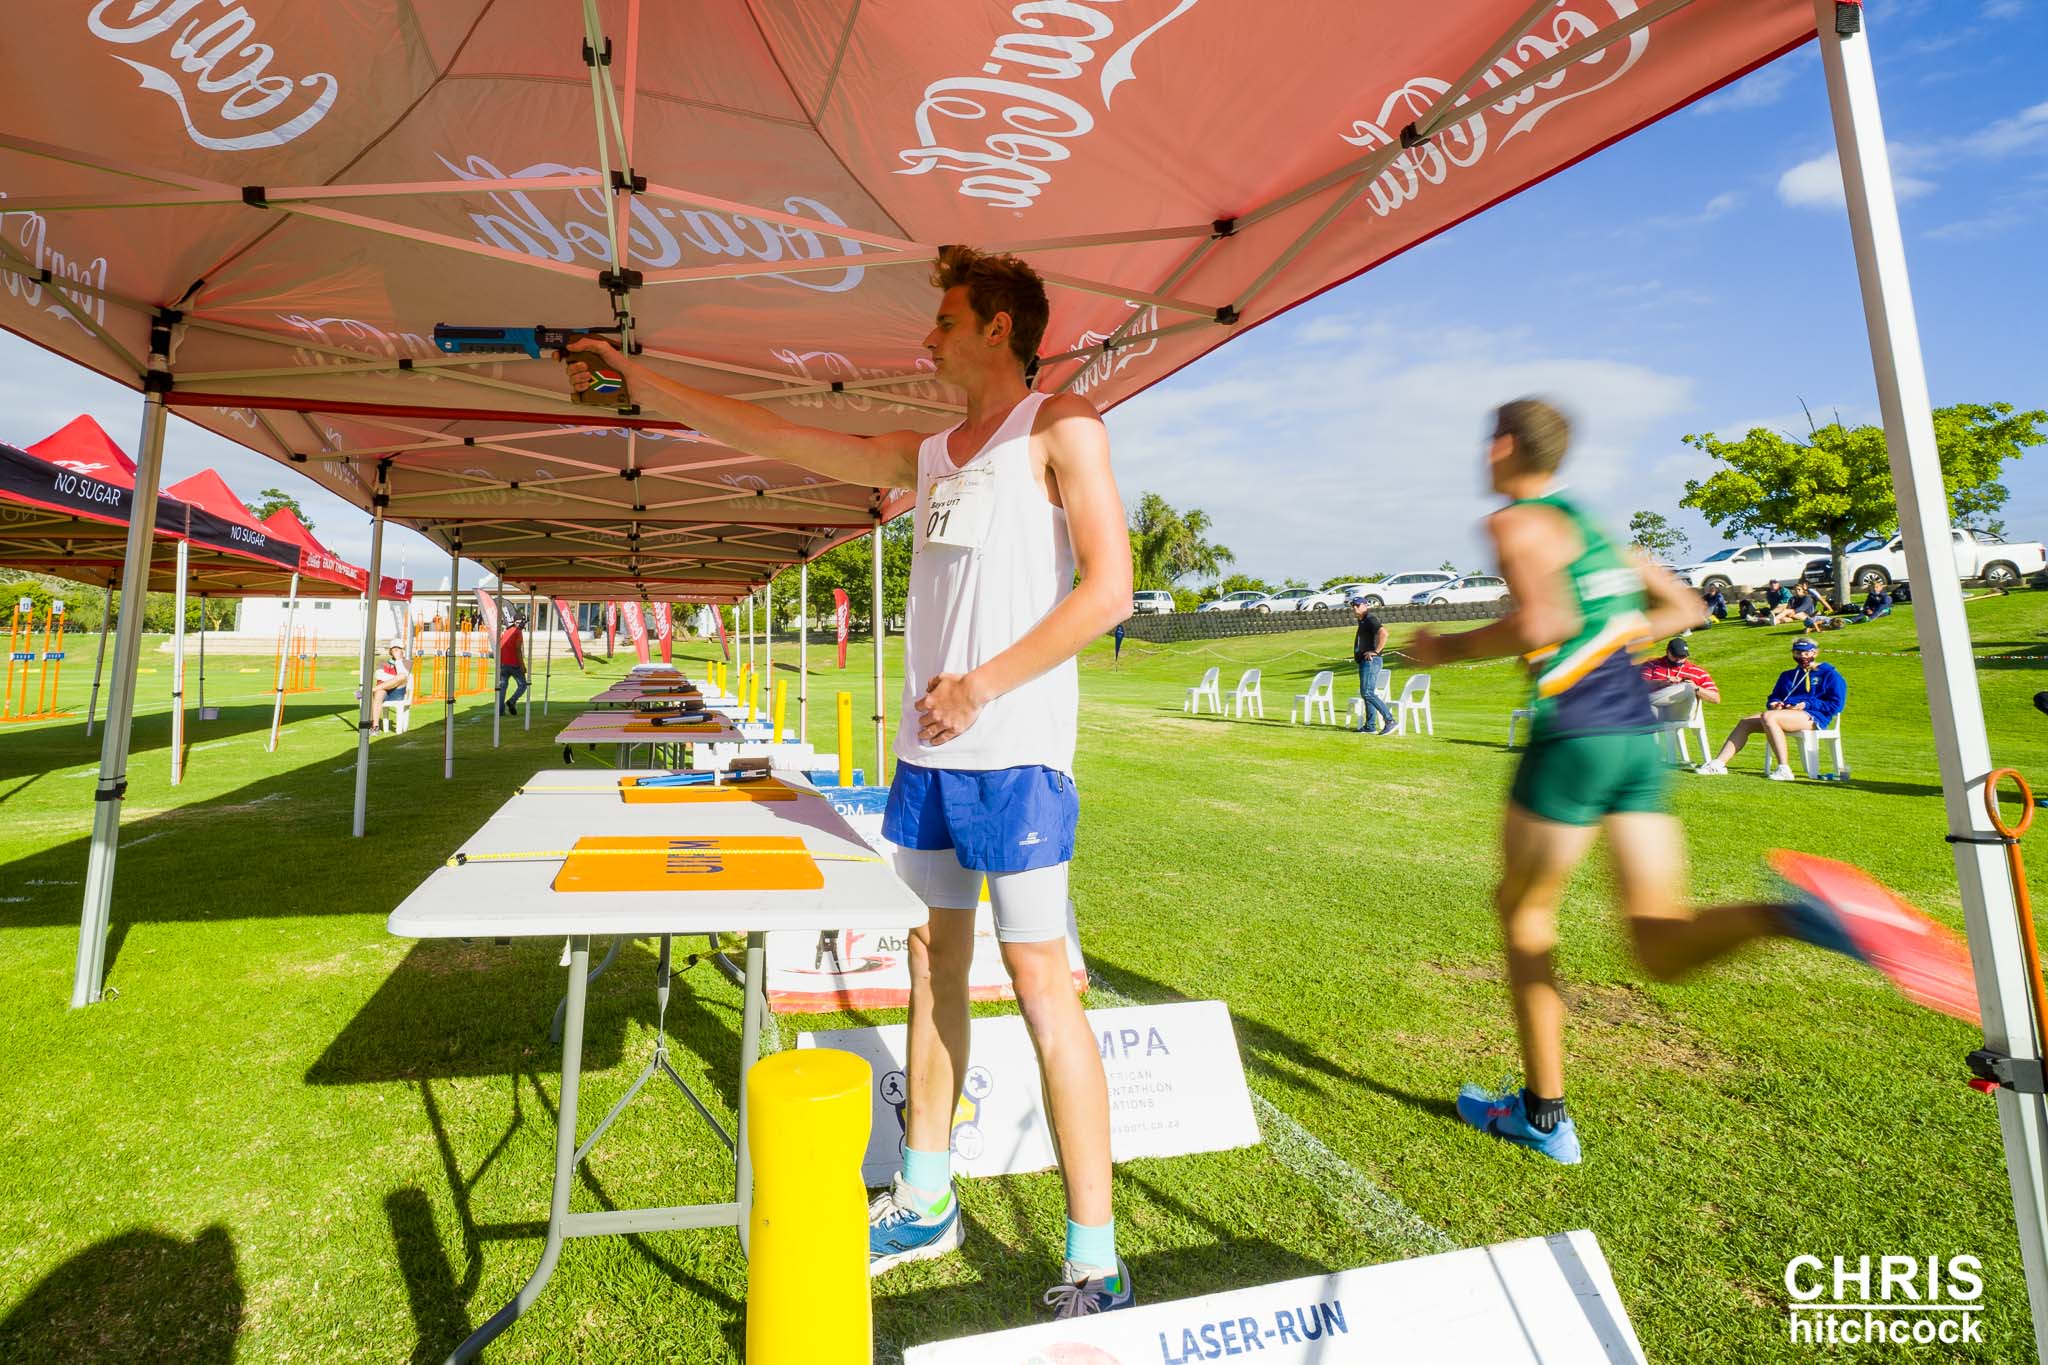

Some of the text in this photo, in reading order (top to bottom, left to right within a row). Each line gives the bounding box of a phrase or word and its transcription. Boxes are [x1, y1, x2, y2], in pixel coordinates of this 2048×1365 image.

[54, 472, 121, 507] NO SUGAR
[926, 509, 951, 538] 01
[231, 525, 266, 548] NO SUGAR
[833, 803, 865, 816] PM
[876, 935, 910, 953] Abs
[1098, 1026, 1170, 1060] MPA
[1108, 1082, 1173, 1096] ENTATHLON
[1112, 1098, 1154, 1111] ATIONS
[1158, 1300, 1349, 1365] LASER-RUN
